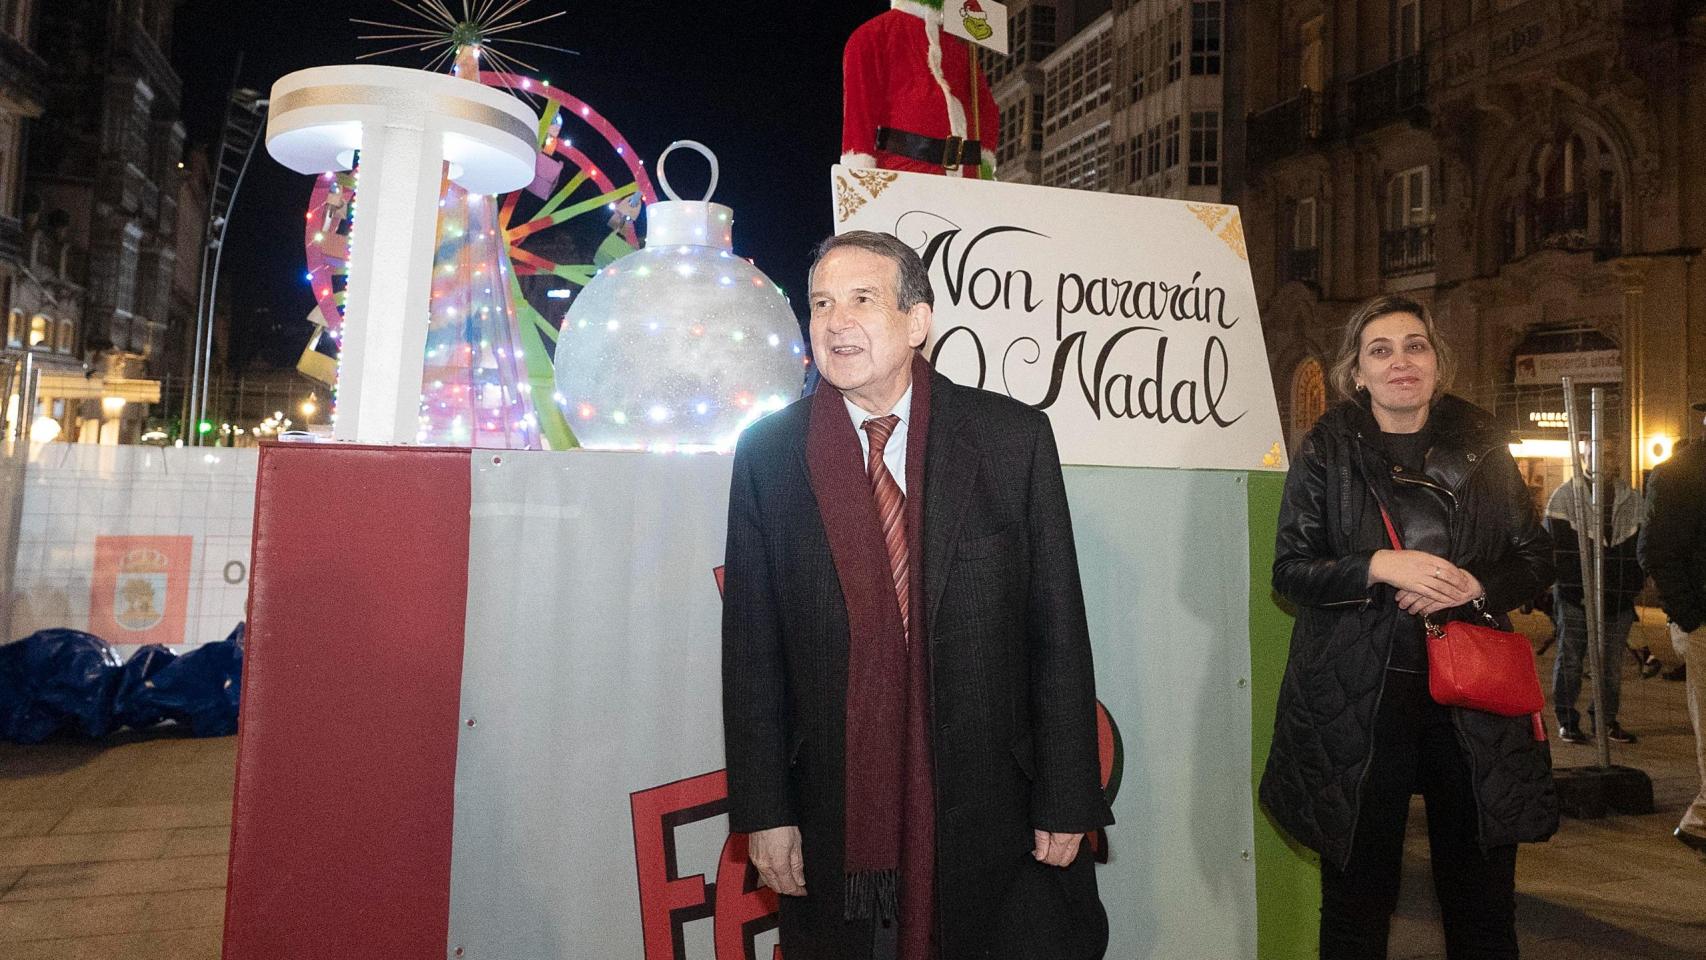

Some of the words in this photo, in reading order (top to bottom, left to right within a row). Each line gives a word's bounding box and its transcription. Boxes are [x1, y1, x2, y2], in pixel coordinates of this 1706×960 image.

[896, 210, 1051, 313] Non
[1056, 271, 1239, 341] pararán
[1003, 326, 1247, 428] Nadal
